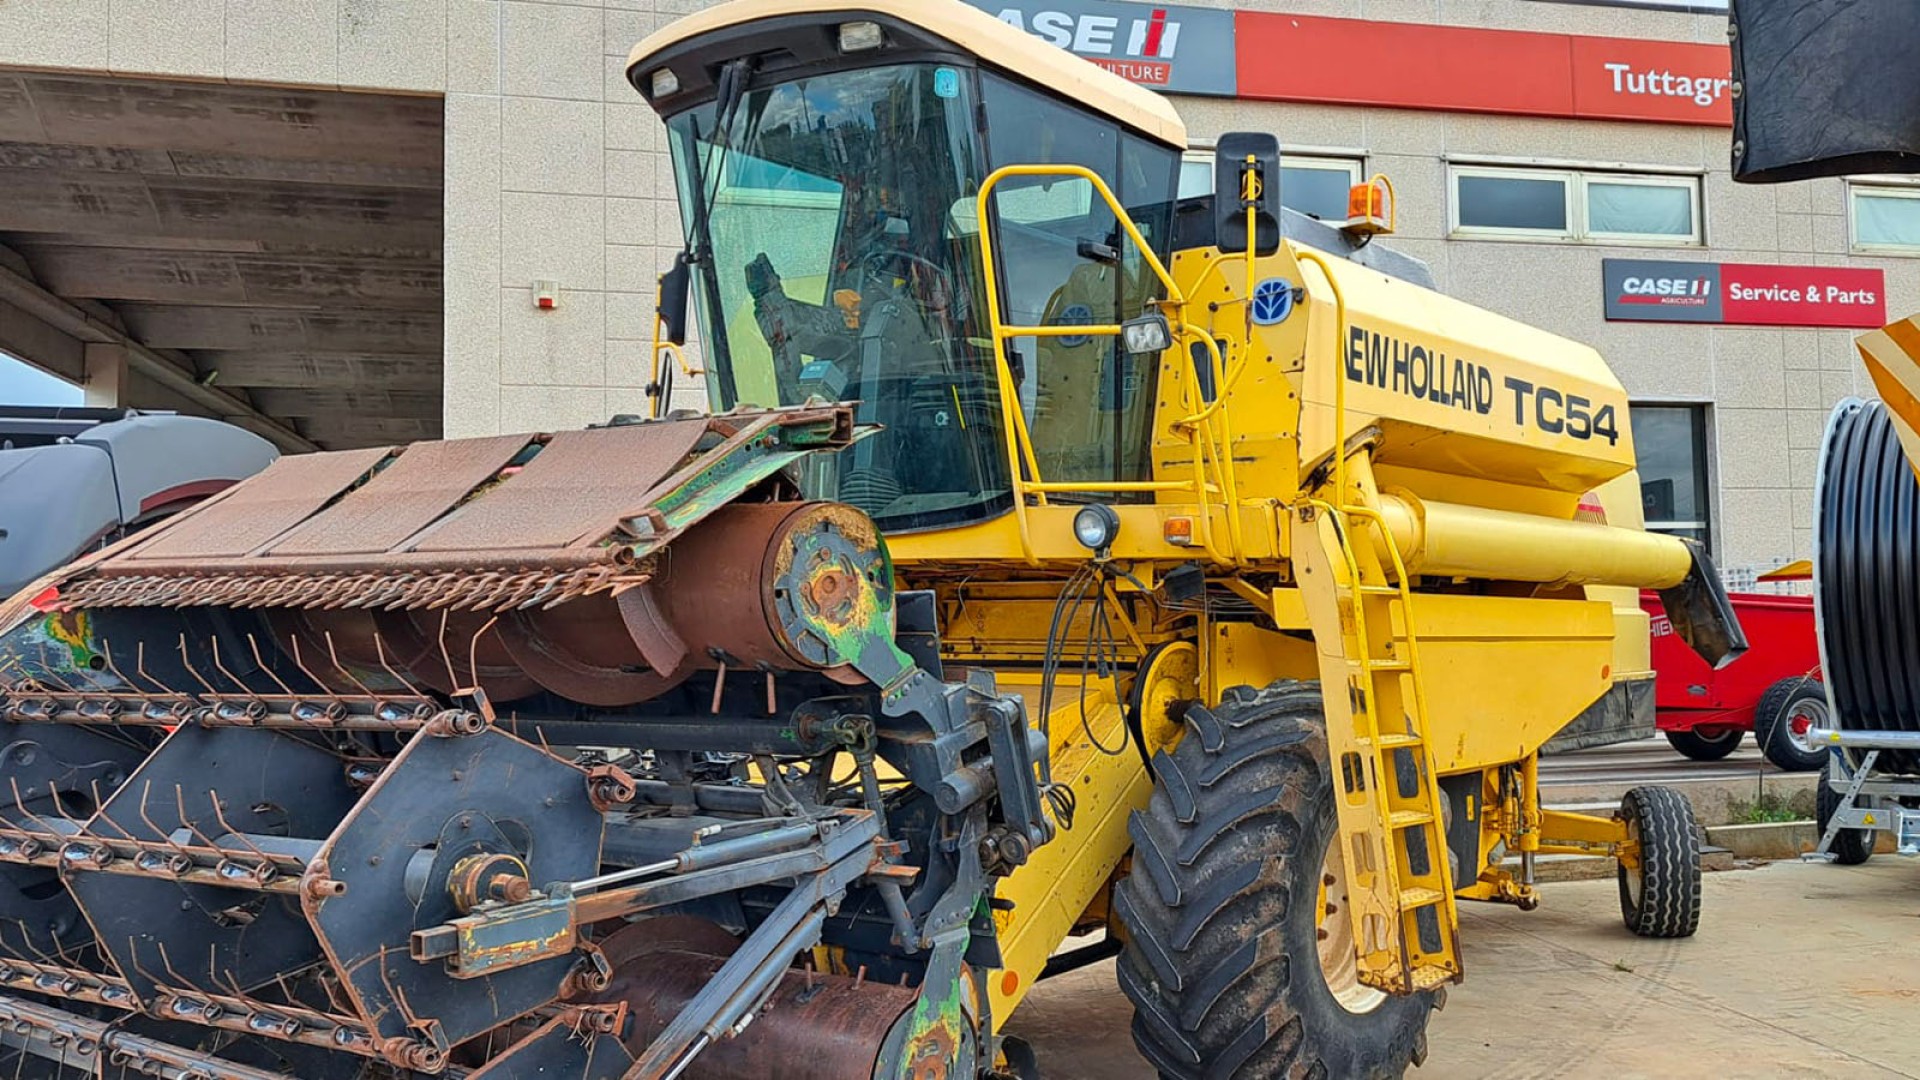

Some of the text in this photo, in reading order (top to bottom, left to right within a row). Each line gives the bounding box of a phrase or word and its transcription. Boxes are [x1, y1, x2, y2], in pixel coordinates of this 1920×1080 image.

[997, 9, 1118, 54] ASE
[1622, 277, 1688, 294] CASE
[1729, 282, 1876, 304] Service & Parts
[1393, 339, 1493, 414] HOLLAND
[1504, 375, 1618, 446] TC54
